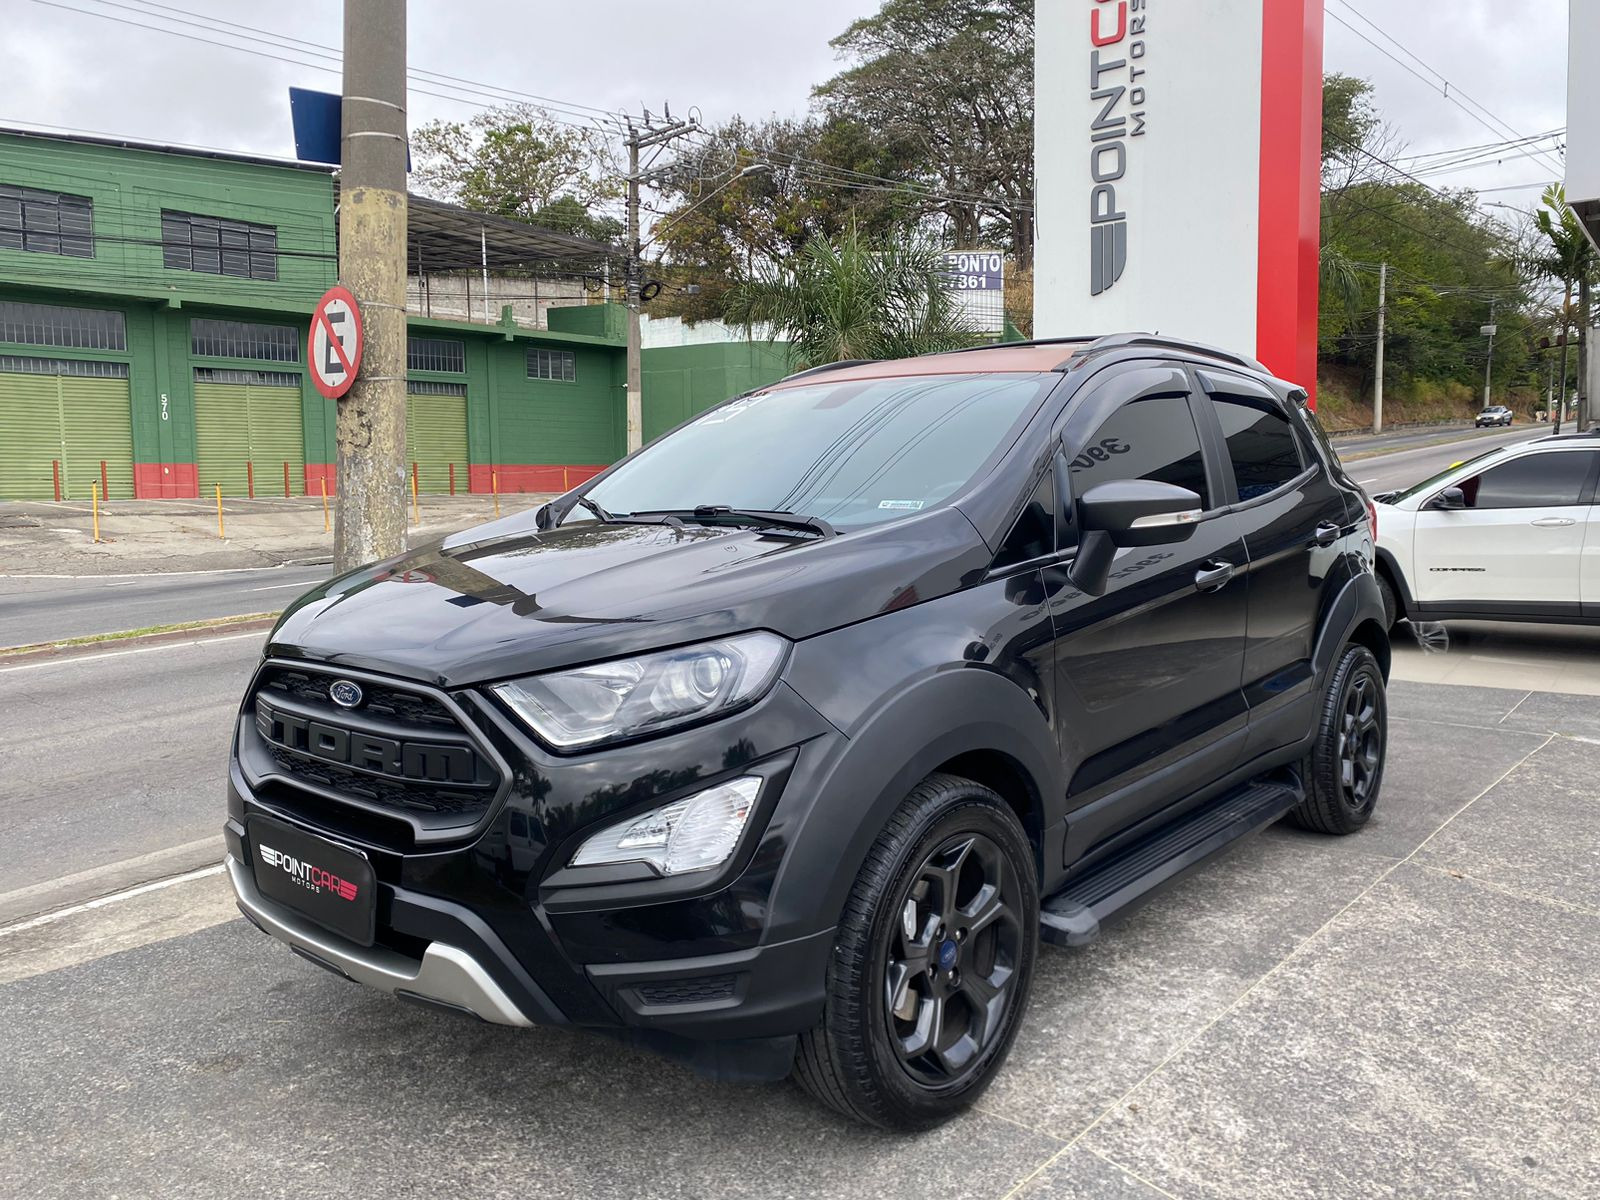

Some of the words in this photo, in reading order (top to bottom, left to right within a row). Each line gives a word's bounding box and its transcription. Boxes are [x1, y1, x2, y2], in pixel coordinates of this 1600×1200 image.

[1129, 0, 1146, 136] MOTORS
[1091, 0, 1127, 224] POINTC
[160, 393, 169, 421] 570
[274, 850, 342, 896] POINTCAR
[291, 876, 320, 894] MOTORS
